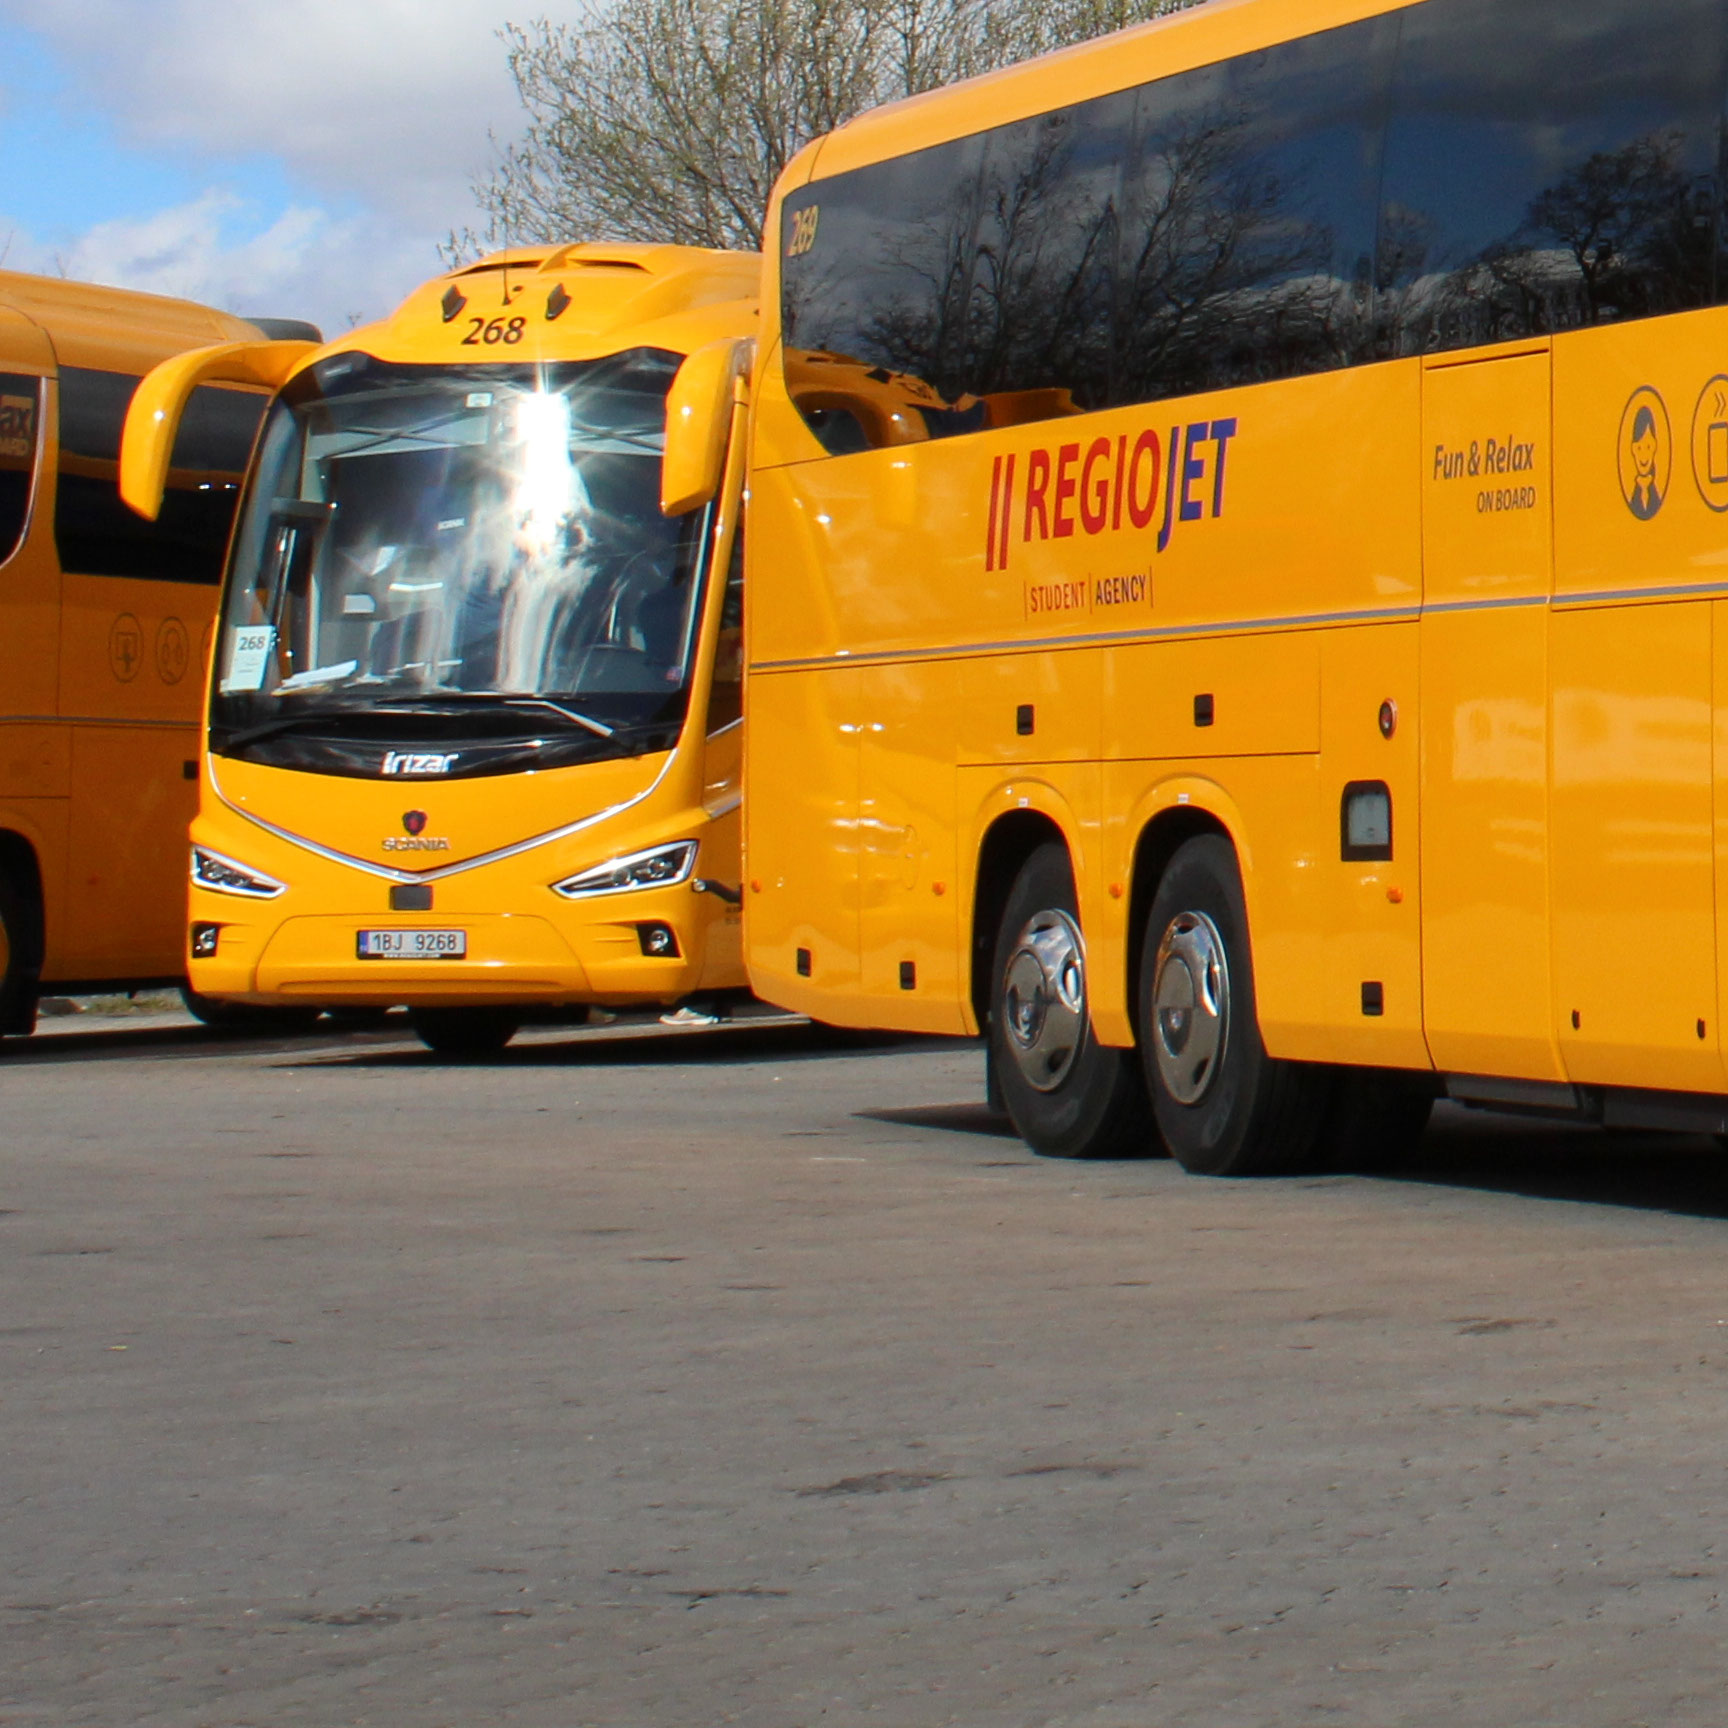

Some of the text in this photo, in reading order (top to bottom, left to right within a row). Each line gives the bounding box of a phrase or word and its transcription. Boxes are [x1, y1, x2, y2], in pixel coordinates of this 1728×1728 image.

[785, 204, 819, 257] 269
[461, 316, 528, 346] 268
[1433, 434, 1535, 481] Fun & Relax
[1023, 417, 1238, 554] REGIOJET
[1477, 486, 1536, 513] ON BOARD
[1030, 574, 1147, 613] STUDENT AGENCY
[239, 635, 266, 651] 268
[373, 933, 403, 951] 1BJ
[415, 933, 457, 951] 9268
